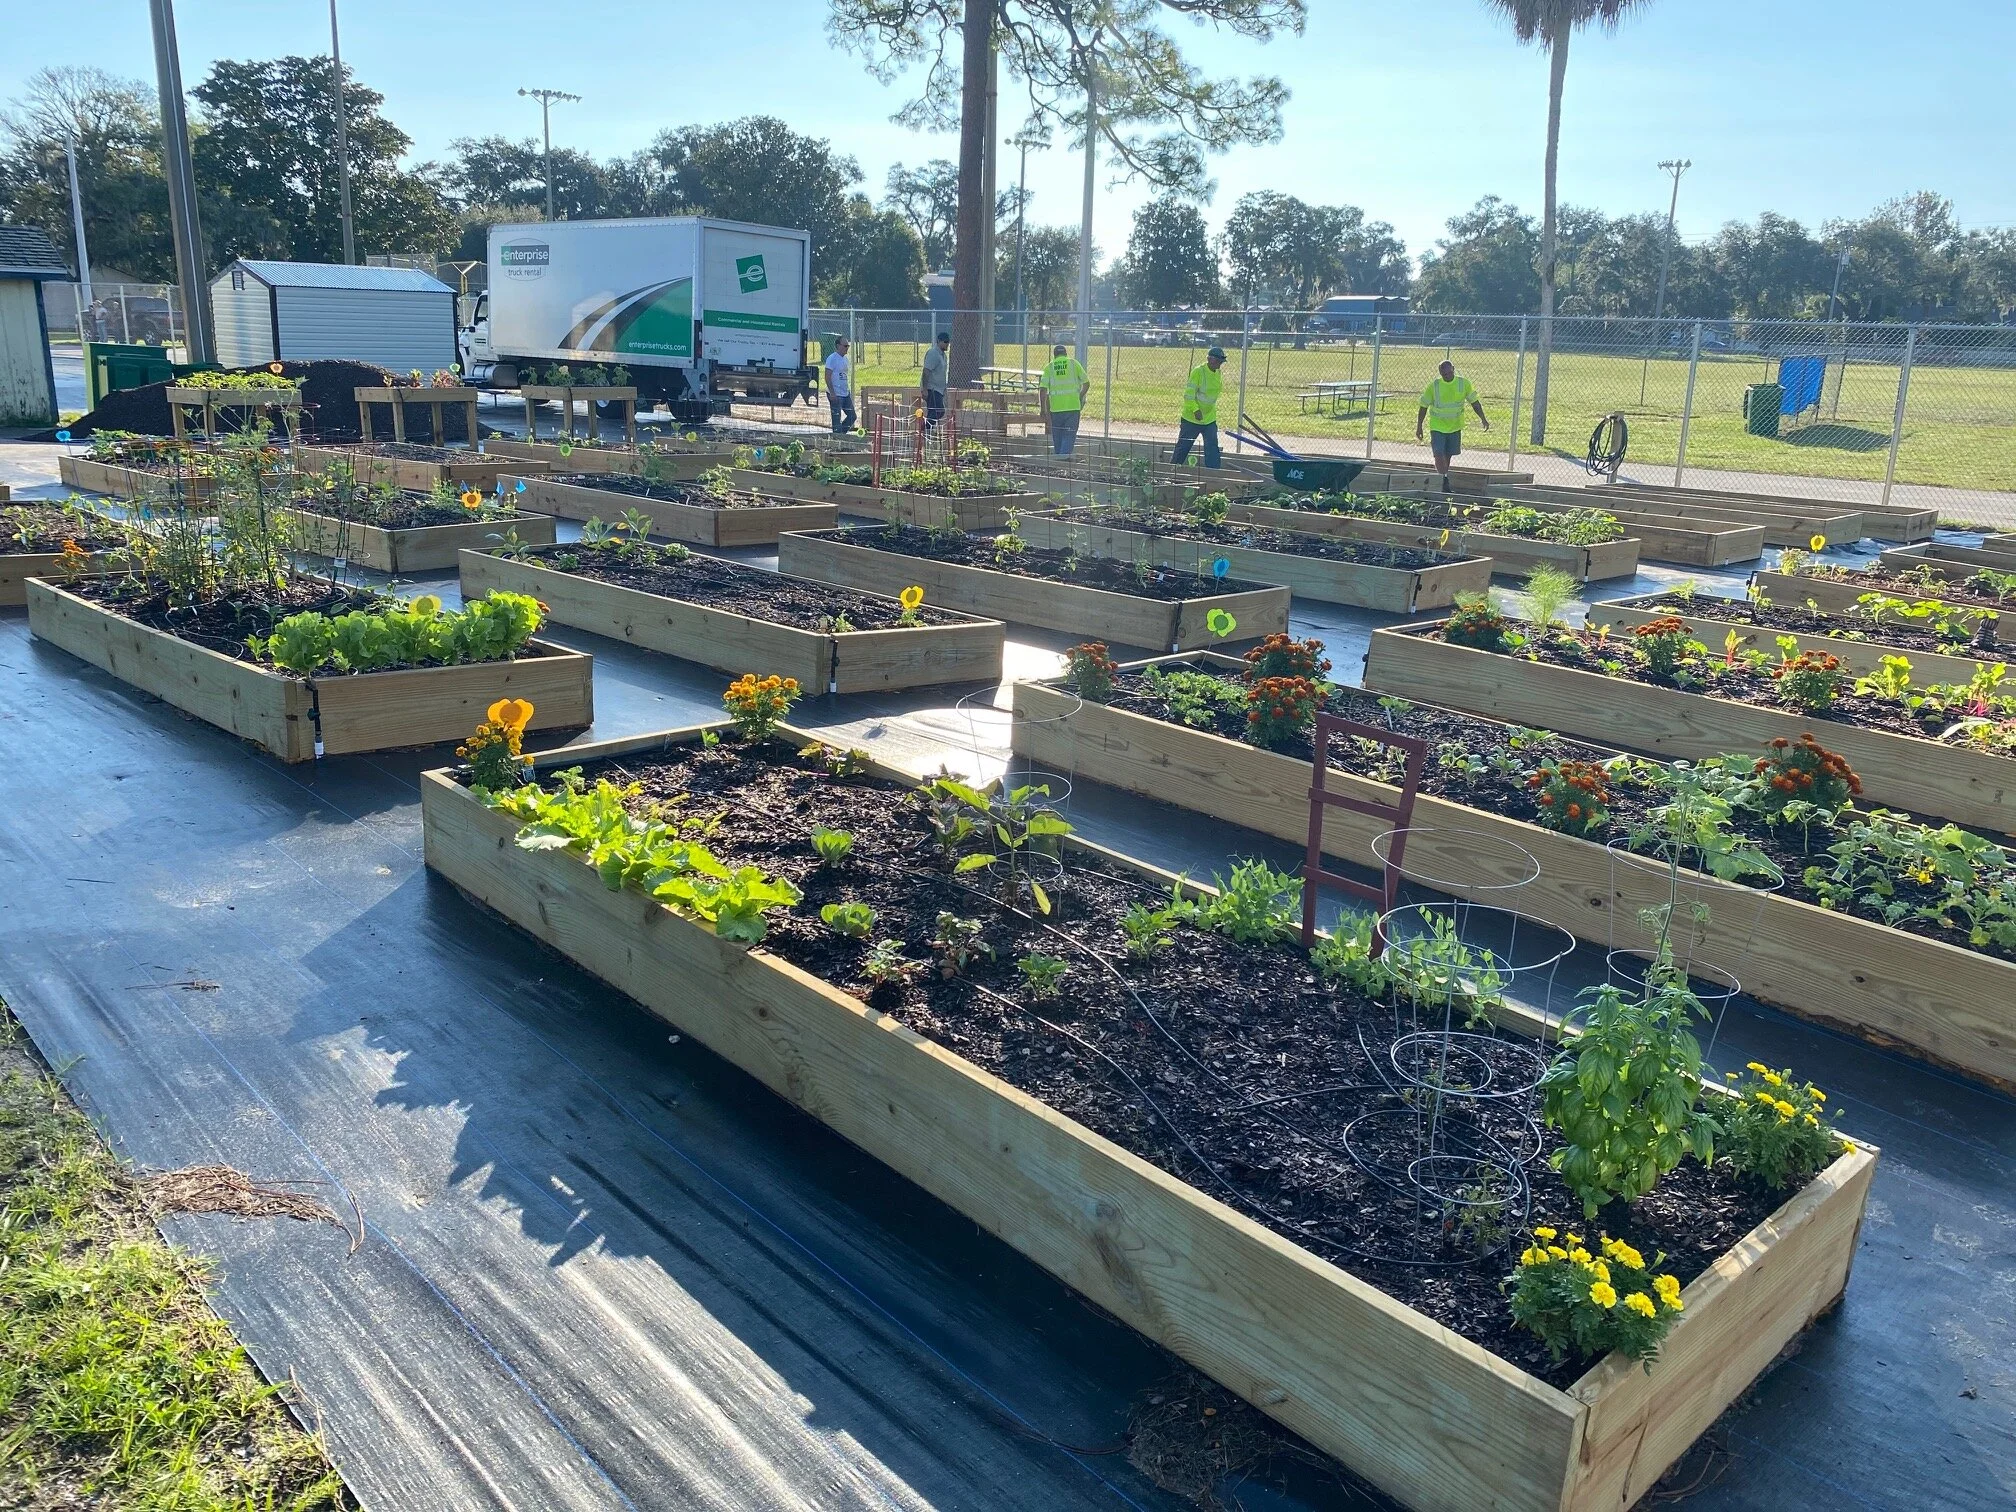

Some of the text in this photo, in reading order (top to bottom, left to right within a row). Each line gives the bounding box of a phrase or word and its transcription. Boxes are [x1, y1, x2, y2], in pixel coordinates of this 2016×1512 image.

[502, 248, 549, 263] enterprise
[508, 267, 542, 276] truck rental
[628, 340, 687, 352] enterprisetrucks.com
[1286, 468, 1305, 480] ACE
